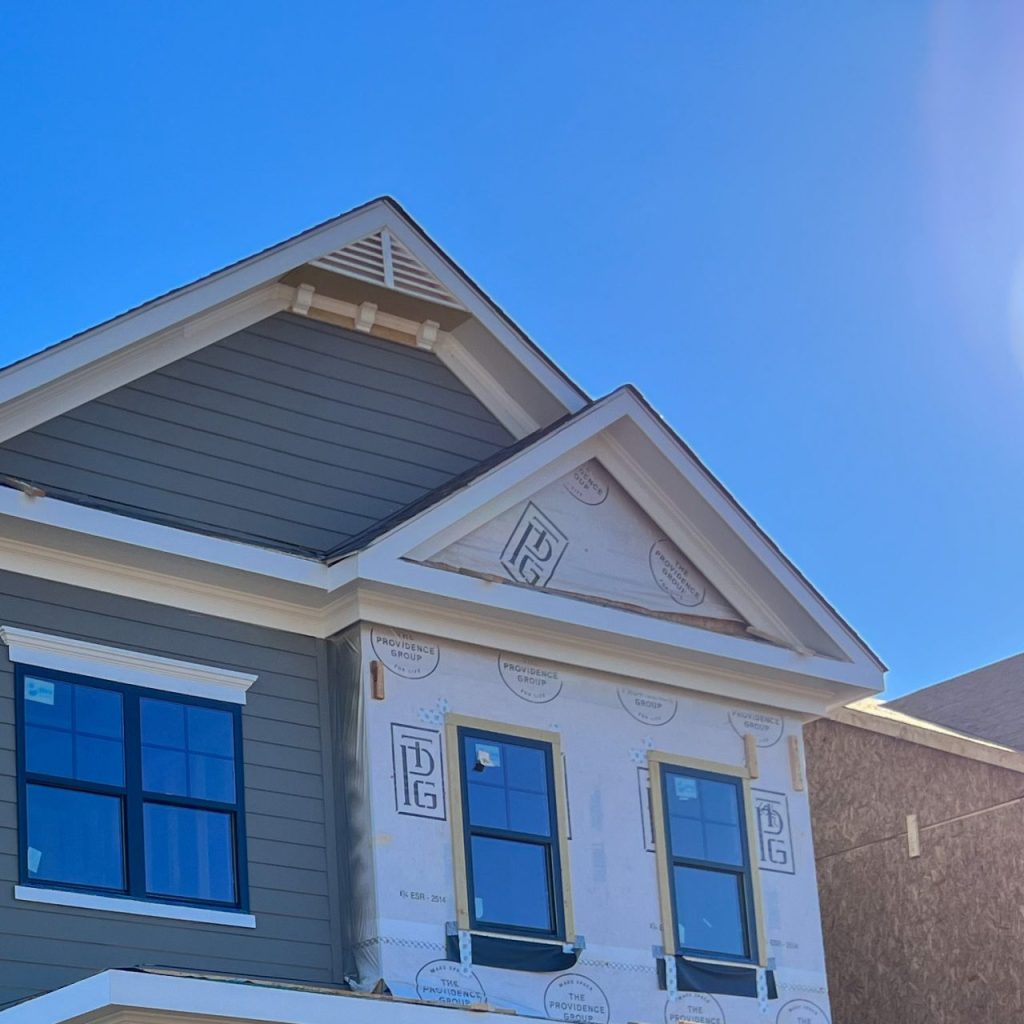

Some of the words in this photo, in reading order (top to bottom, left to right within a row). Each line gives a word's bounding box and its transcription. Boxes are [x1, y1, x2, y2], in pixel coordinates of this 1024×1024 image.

[655, 550, 699, 599] PROVIDENCE
[376, 636, 435, 655] PROVIDENCE
[390, 649, 422, 661] GROUP
[503, 662, 558, 680] PROVIDENCE
[517, 674, 547, 686] GROUP
[634, 698, 662, 709] GROUP
[440, 978, 460, 988] THE
[422, 985, 482, 1001] PROVIDENCE
[568, 992, 585, 1001] THE
[548, 1000, 605, 1014] PROVIDENCE
[687, 1005, 703, 1014] THE
[564, 1012, 594, 1023] GROUP
